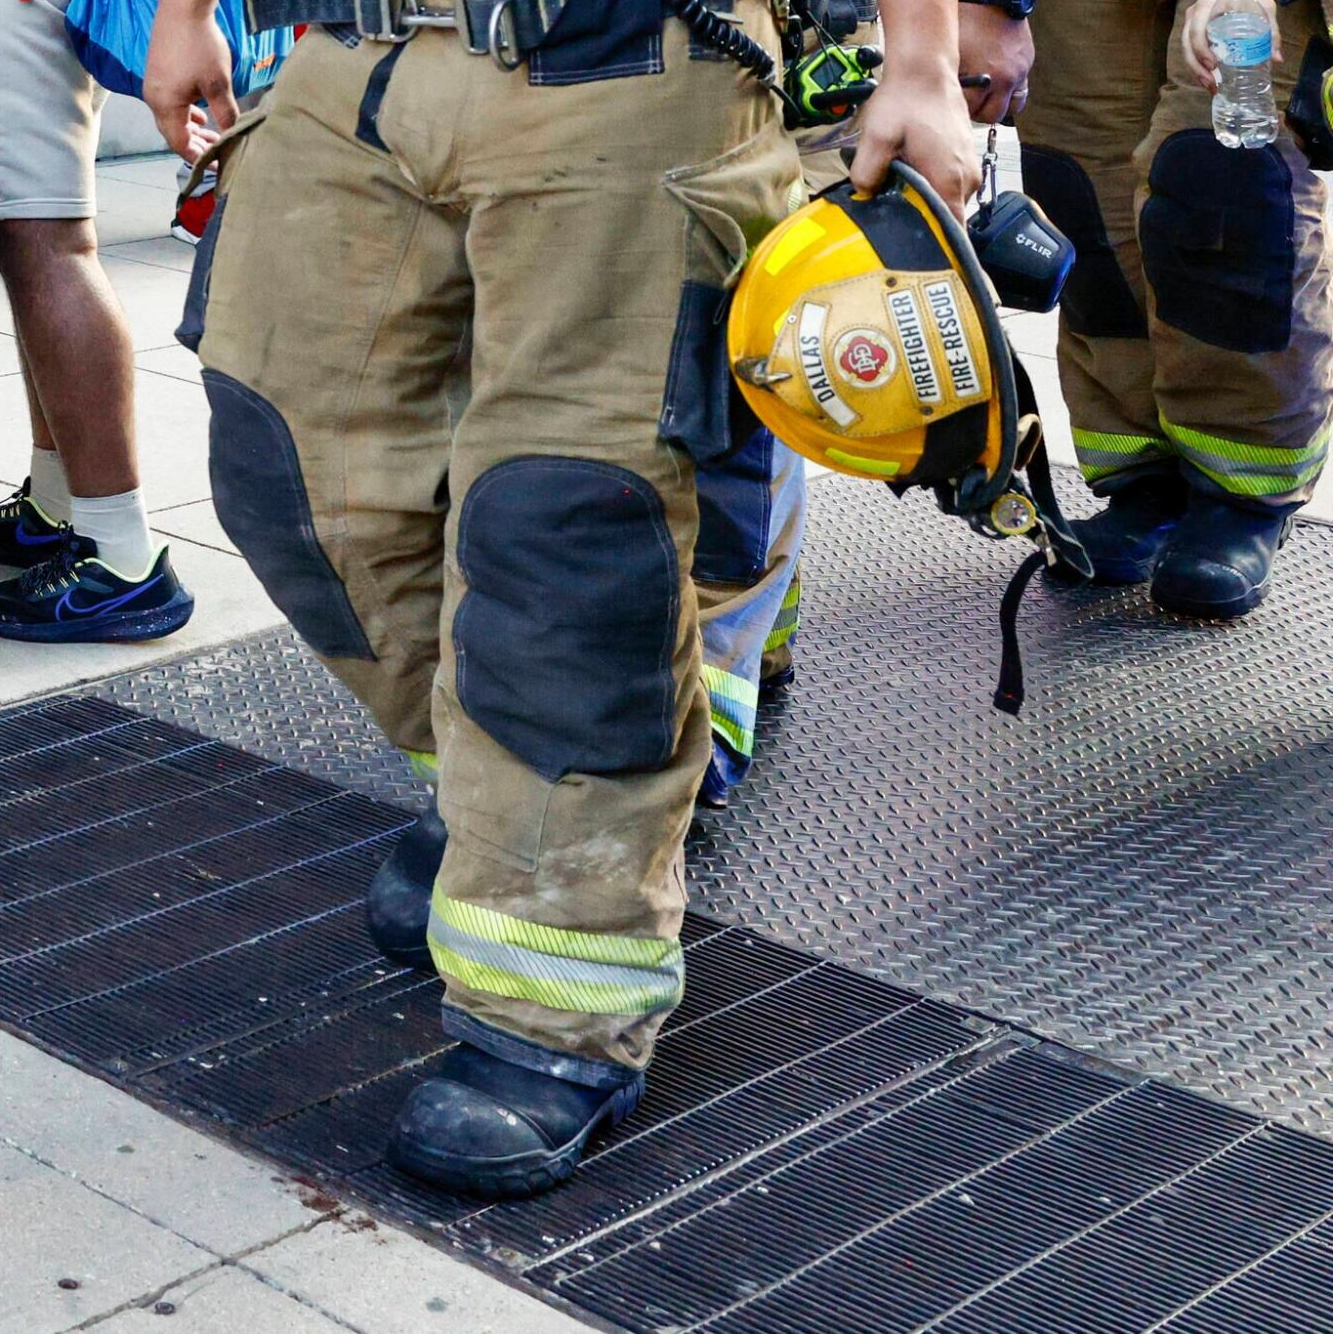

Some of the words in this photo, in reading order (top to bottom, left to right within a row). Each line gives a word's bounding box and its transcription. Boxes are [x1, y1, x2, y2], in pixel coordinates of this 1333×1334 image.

[1024, 238, 1052, 259] FLIR
[801, 335, 835, 403] DALLAS
[891, 294, 937, 399] FIREFIGHTER
[928, 286, 975, 392] FIRE-RESCUE
